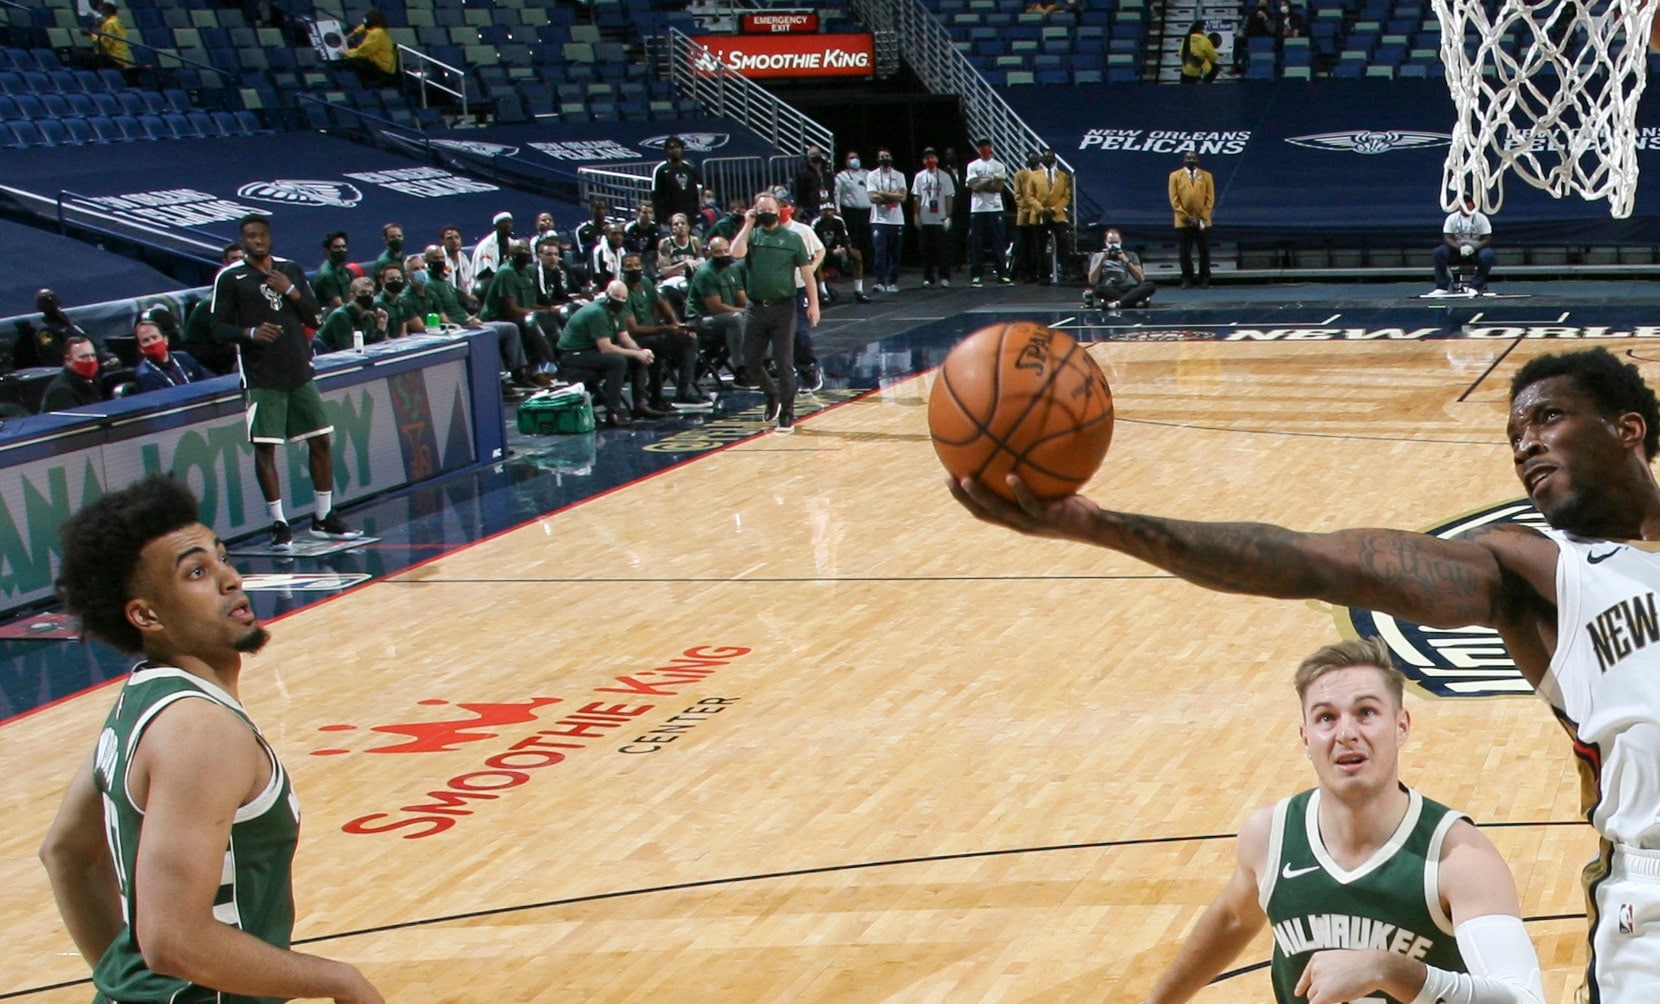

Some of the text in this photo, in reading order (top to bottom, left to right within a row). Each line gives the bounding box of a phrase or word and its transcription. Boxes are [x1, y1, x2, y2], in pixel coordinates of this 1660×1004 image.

[754, 16, 808, 24] EMERGENCY
[727, 51, 820, 70] SMOOTHIE
[1078, 135, 1247, 154] PELICANS
[1087, 129, 1252, 141] NEW ORLEANS
[1226, 327, 1441, 340] NEW
[1586, 592, 1660, 675] NEW
[618, 696, 742, 754] CENTER
[341, 701, 656, 839] SMOOTHIE
